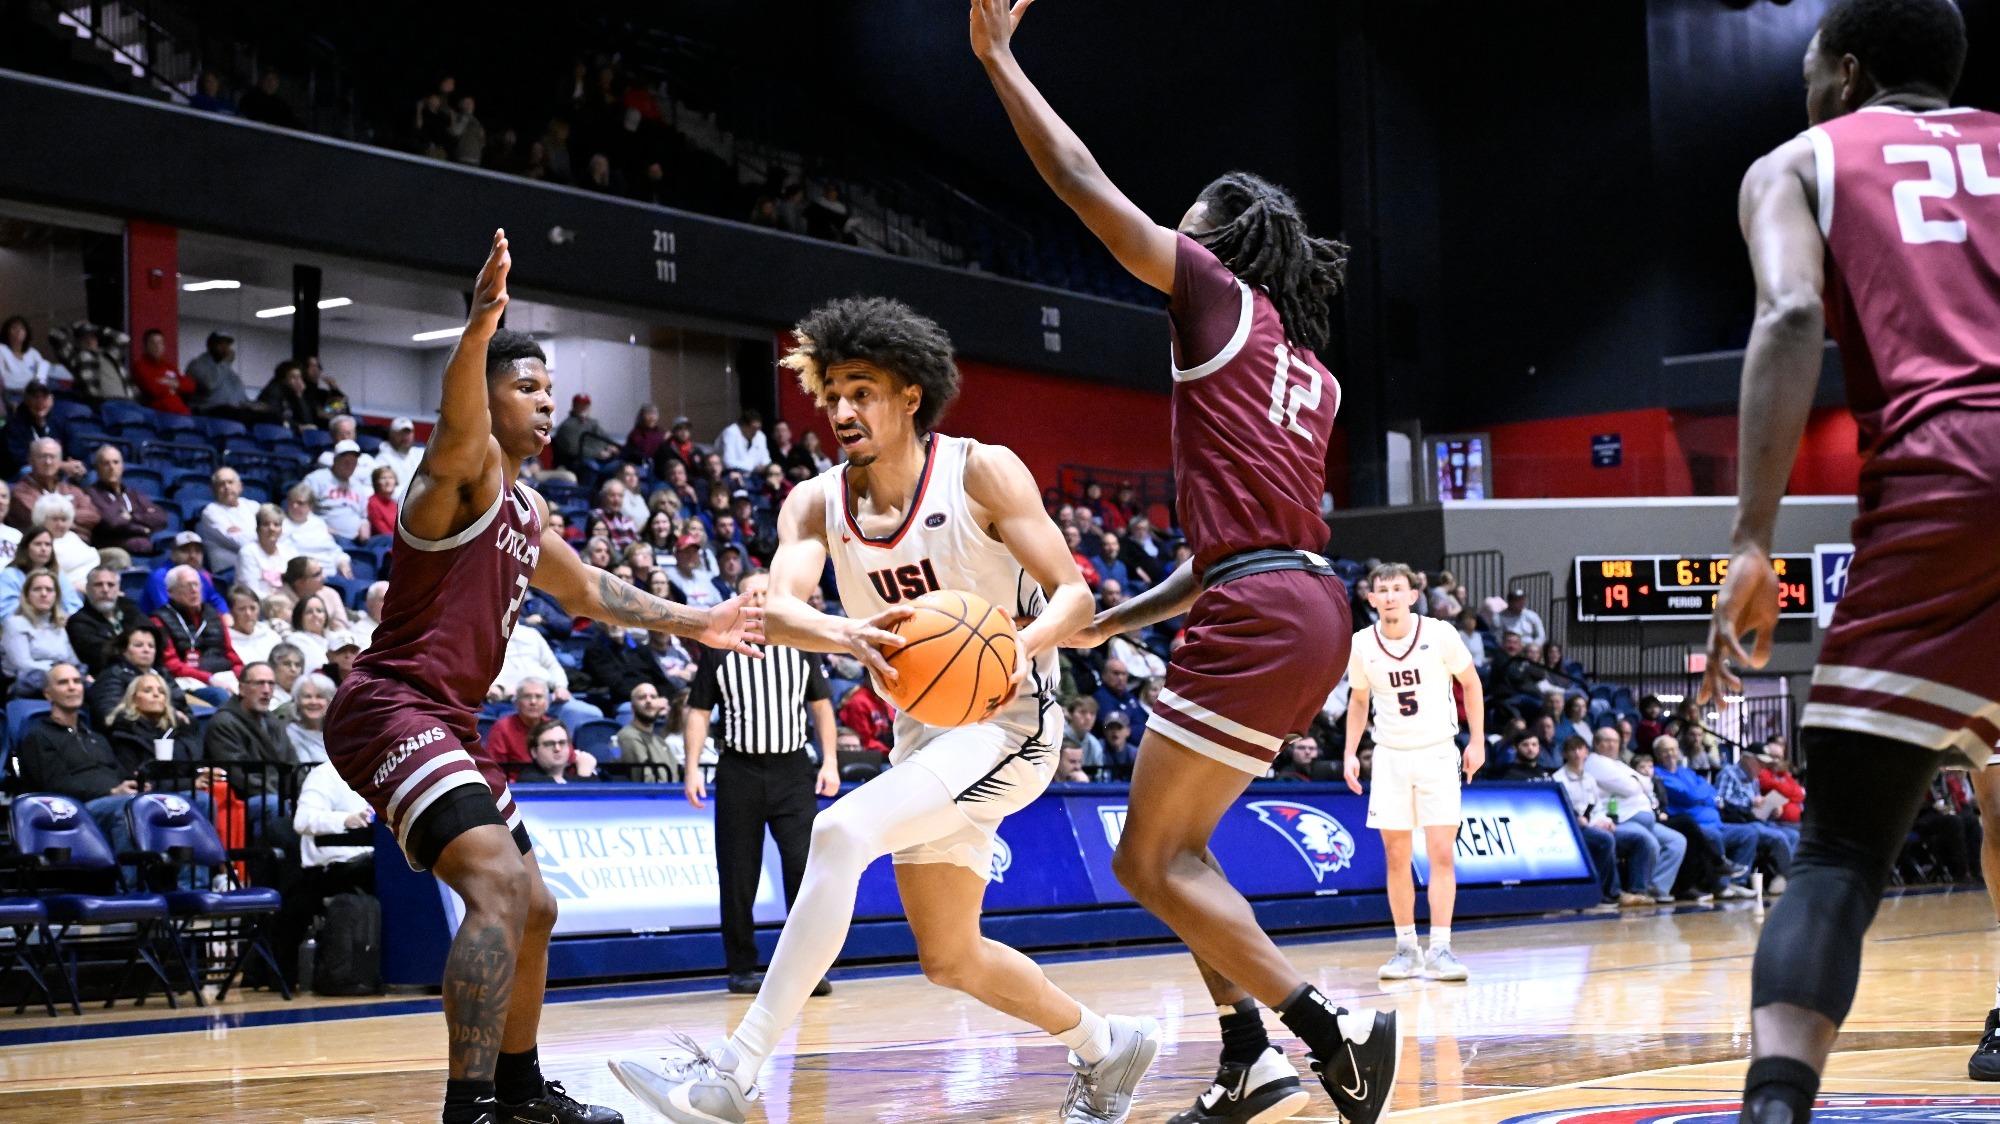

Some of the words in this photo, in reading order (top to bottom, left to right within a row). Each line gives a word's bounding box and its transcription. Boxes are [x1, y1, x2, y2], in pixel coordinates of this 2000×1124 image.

[1882, 143, 2000, 244] 24
[652, 229, 676, 254] 211
[655, 259, 677, 283] 111
[1268, 343, 1323, 443] 12
[867, 558, 941, 604] USI
[1601, 560, 1633, 578] USI
[1604, 584, 1629, 609] 19
[1667, 596, 1703, 609] PERIOD
[1388, 668, 1421, 688] USI
[1397, 690, 1419, 717] 5
[373, 726, 446, 789] TROJANS
[549, 825, 713, 859] TRI-STATE
